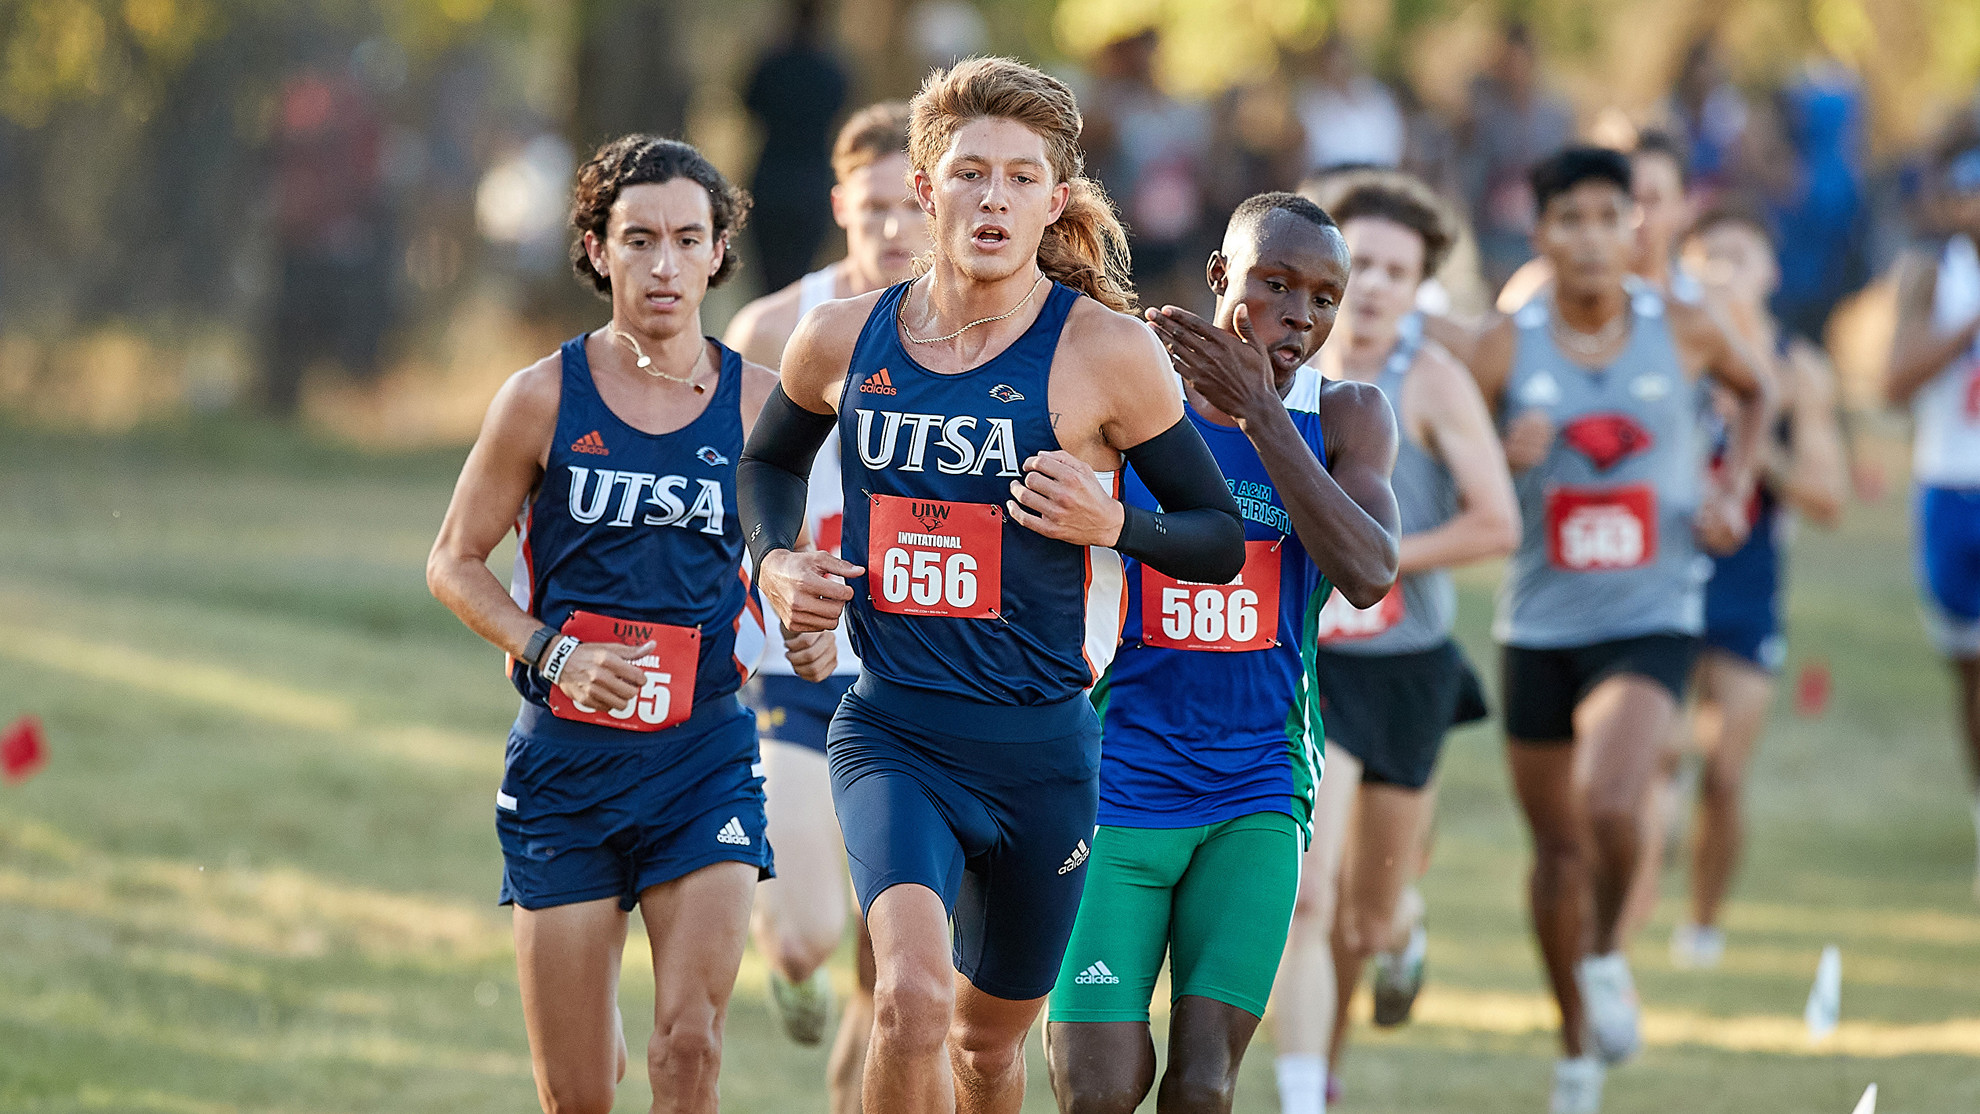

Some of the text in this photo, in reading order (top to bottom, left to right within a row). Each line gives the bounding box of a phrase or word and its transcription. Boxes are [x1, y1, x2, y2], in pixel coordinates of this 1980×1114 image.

[859, 383, 897, 397] adidas
[571, 443, 610, 456] adidas
[854, 408, 1023, 478] UTSA
[567, 465, 726, 537] UTSA
[1238, 480, 1272, 503] A&M
[911, 502, 951, 520] UIW
[1233, 495, 1292, 535] HRISTI
[897, 531, 962, 549] INVITATIONAL
[882, 547, 978, 608] 656
[1161, 587, 1259, 642] 586
[613, 621, 654, 641] UIW
[716, 833, 751, 846] adidas
[1057, 847, 1090, 875] adidas
[1074, 973, 1120, 985] adidas
